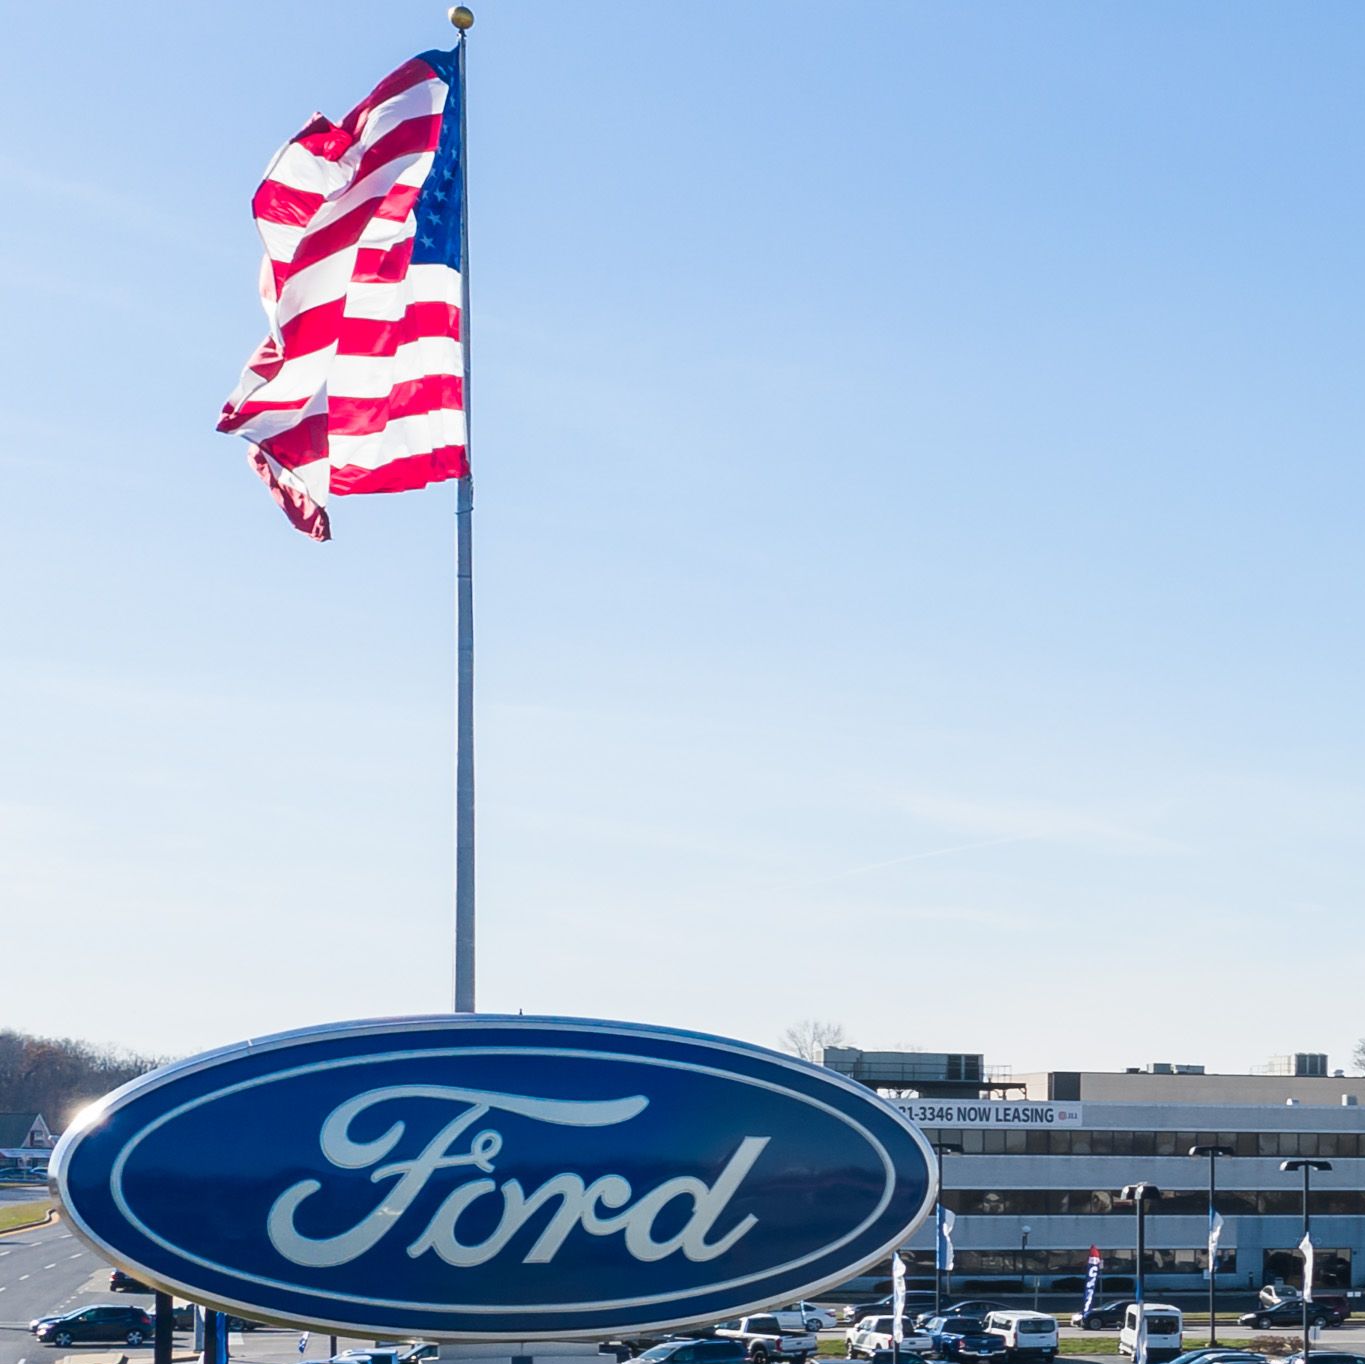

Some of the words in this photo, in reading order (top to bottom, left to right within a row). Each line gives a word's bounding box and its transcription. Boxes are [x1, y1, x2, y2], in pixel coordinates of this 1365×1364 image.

[957, 1106, 990, 1122] NOW
[995, 1107, 1054, 1123] LEASING
[267, 1084, 771, 1267] Ford
